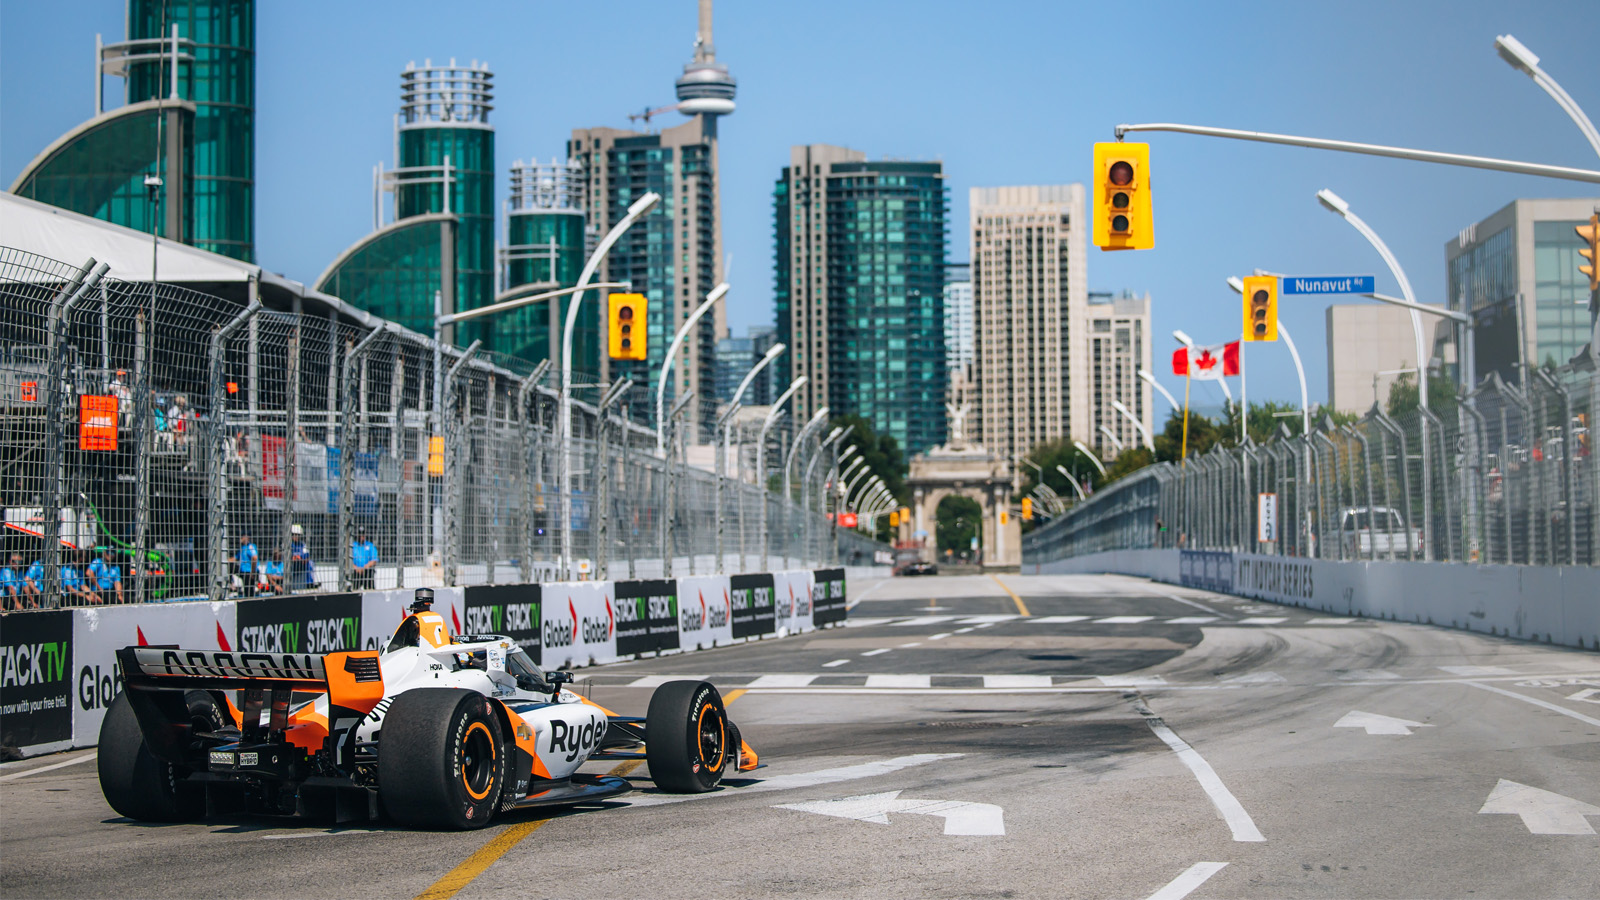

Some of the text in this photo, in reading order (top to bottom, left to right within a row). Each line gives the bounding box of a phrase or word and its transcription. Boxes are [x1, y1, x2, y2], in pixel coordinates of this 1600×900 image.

[1295, 277, 1363, 292] Nunavut Rd
[1284, 564, 1313, 598] SERIES
[467, 603, 540, 635] STACKTV STACKTV
[615, 595, 676, 622] STACKTV STACKTV
[682, 605, 726, 632] Global Global
[241, 622, 300, 653] STACKTV
[307, 617, 359, 653] STACKTV
[421, 615, 443, 645] 7
[544, 616, 608, 648] Global Global
[3, 702, 16, 715] now
[17, 699, 29, 712] with
[30, 699, 43, 714] your
[44, 696, 55, 709] free
[56, 694, 67, 708] trial
[691, 688, 709, 721] Firestone
[332, 717, 358, 765] 7
[453, 712, 469, 777] Firestone
